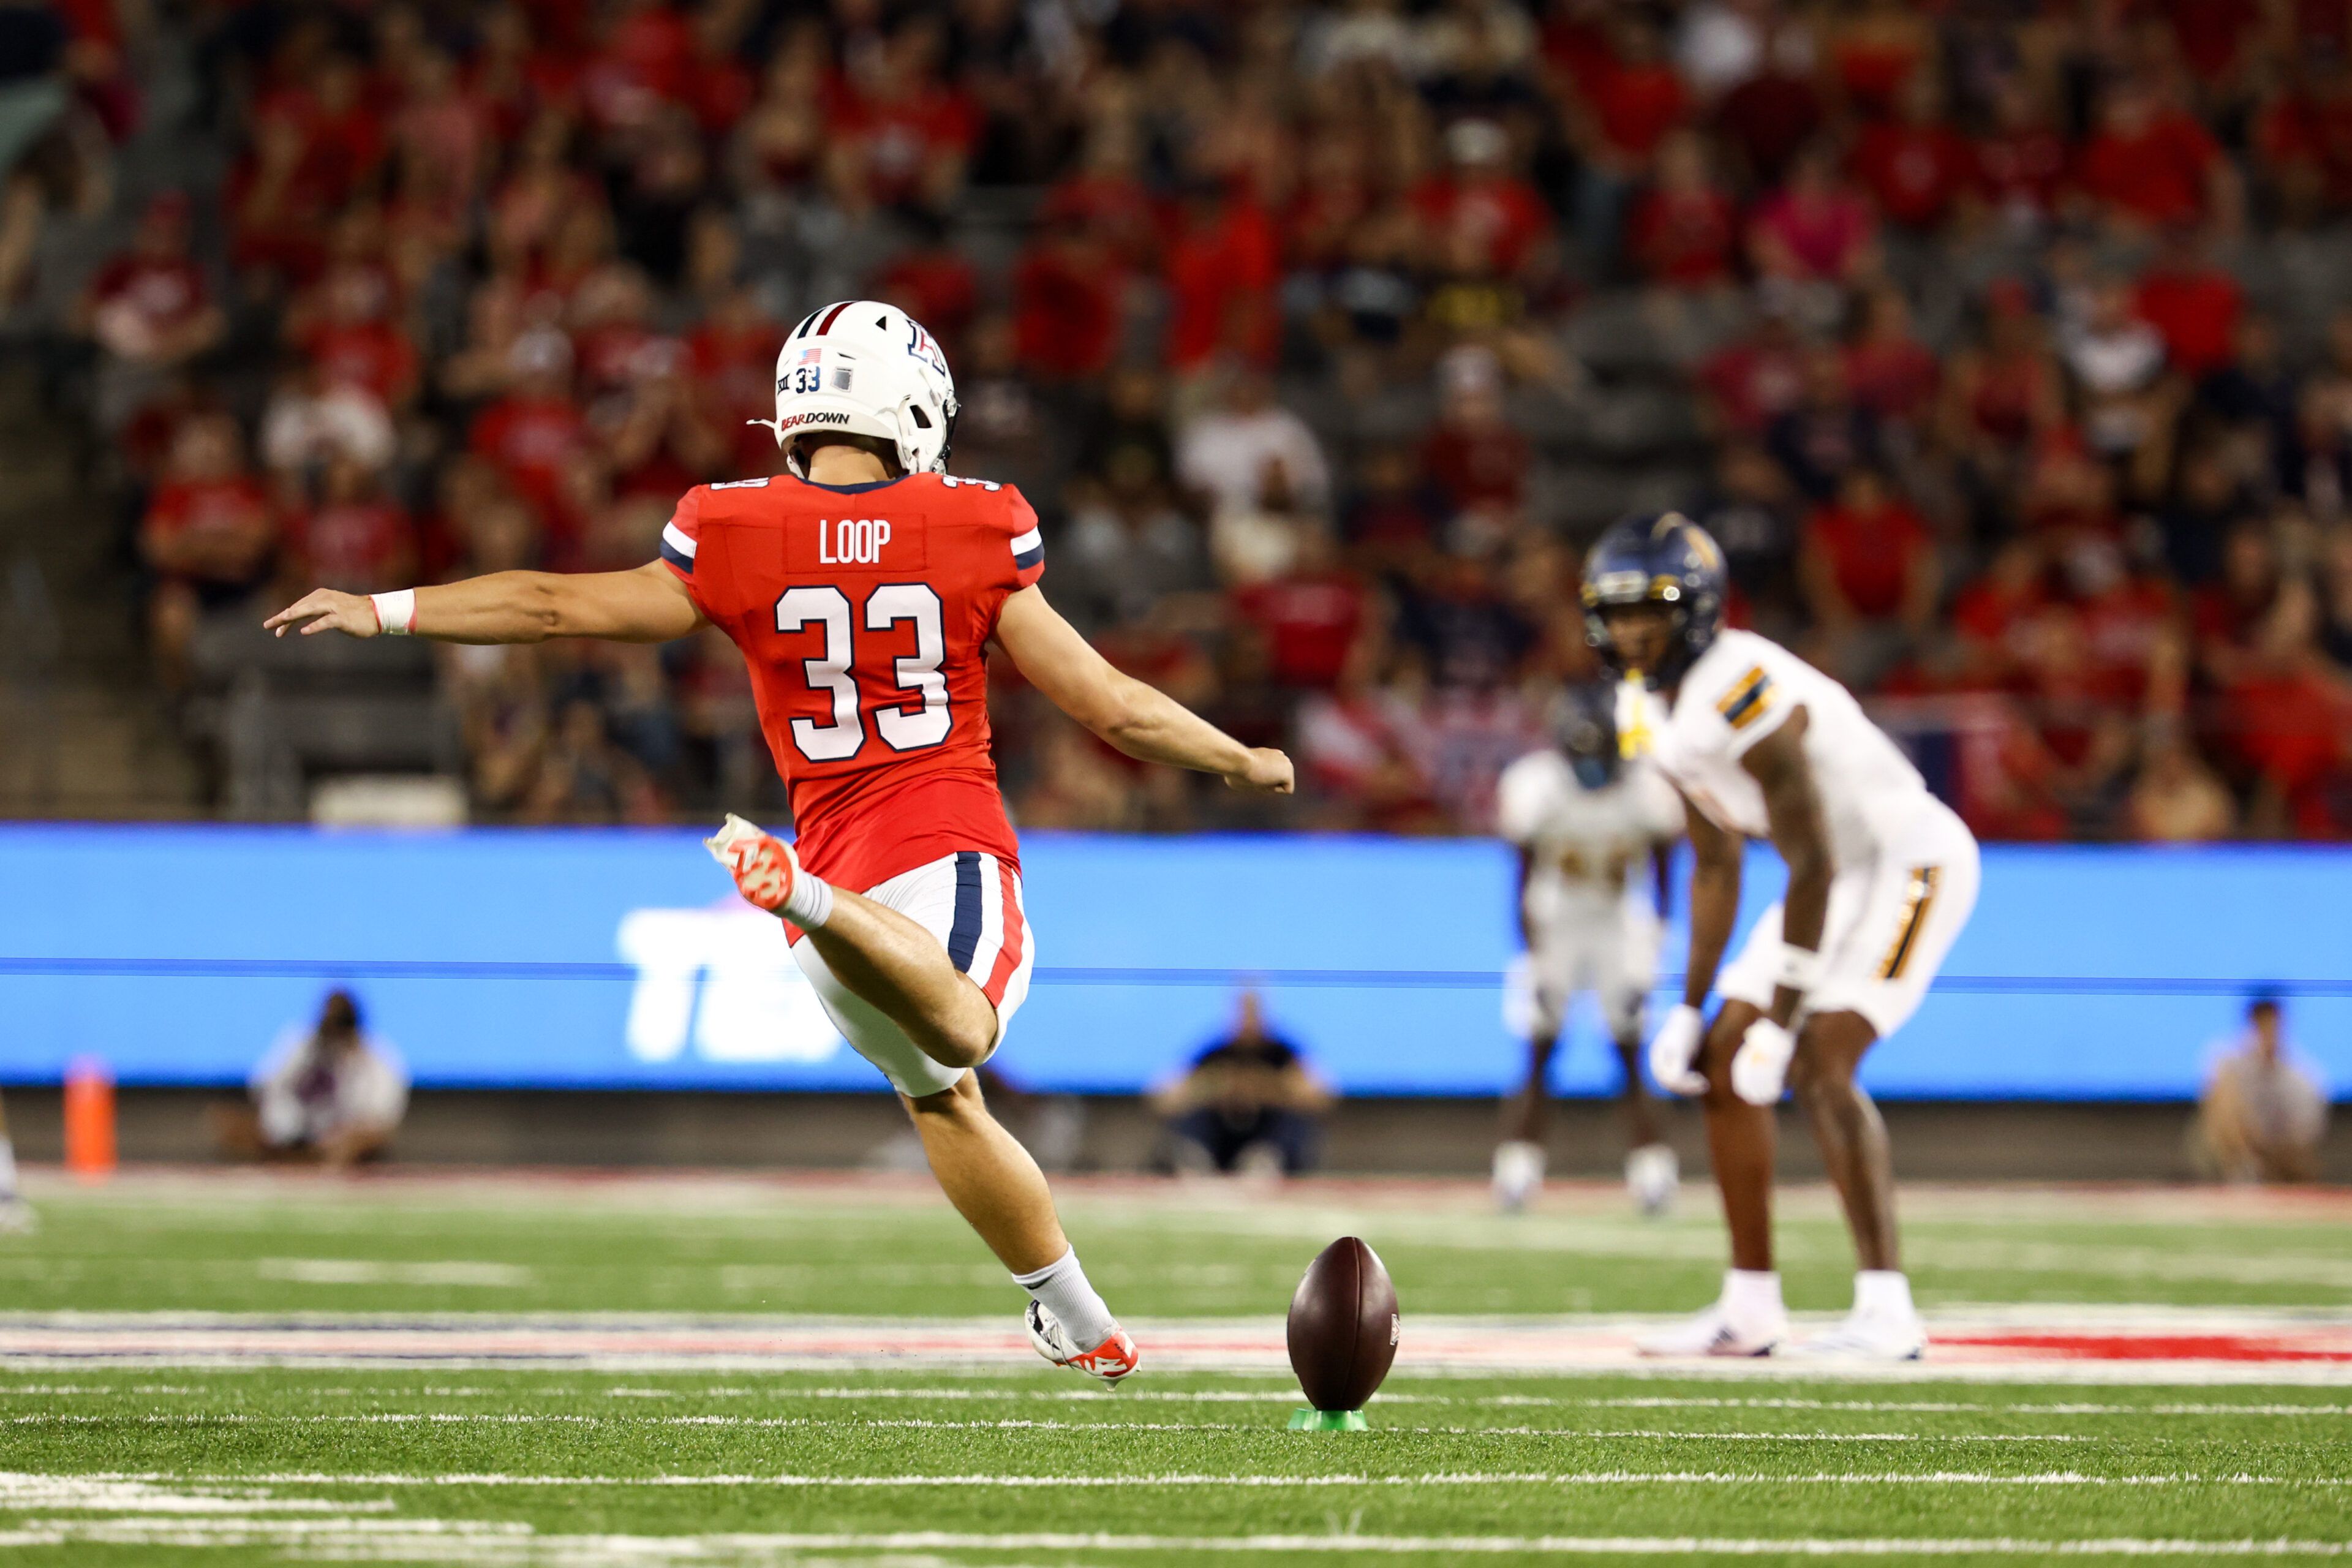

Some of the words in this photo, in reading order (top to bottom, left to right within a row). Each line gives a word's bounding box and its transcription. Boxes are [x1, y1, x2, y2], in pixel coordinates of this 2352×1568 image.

[795, 366, 821, 394] 33
[819, 519, 891, 564] LOOP
[774, 581, 954, 763] 33
